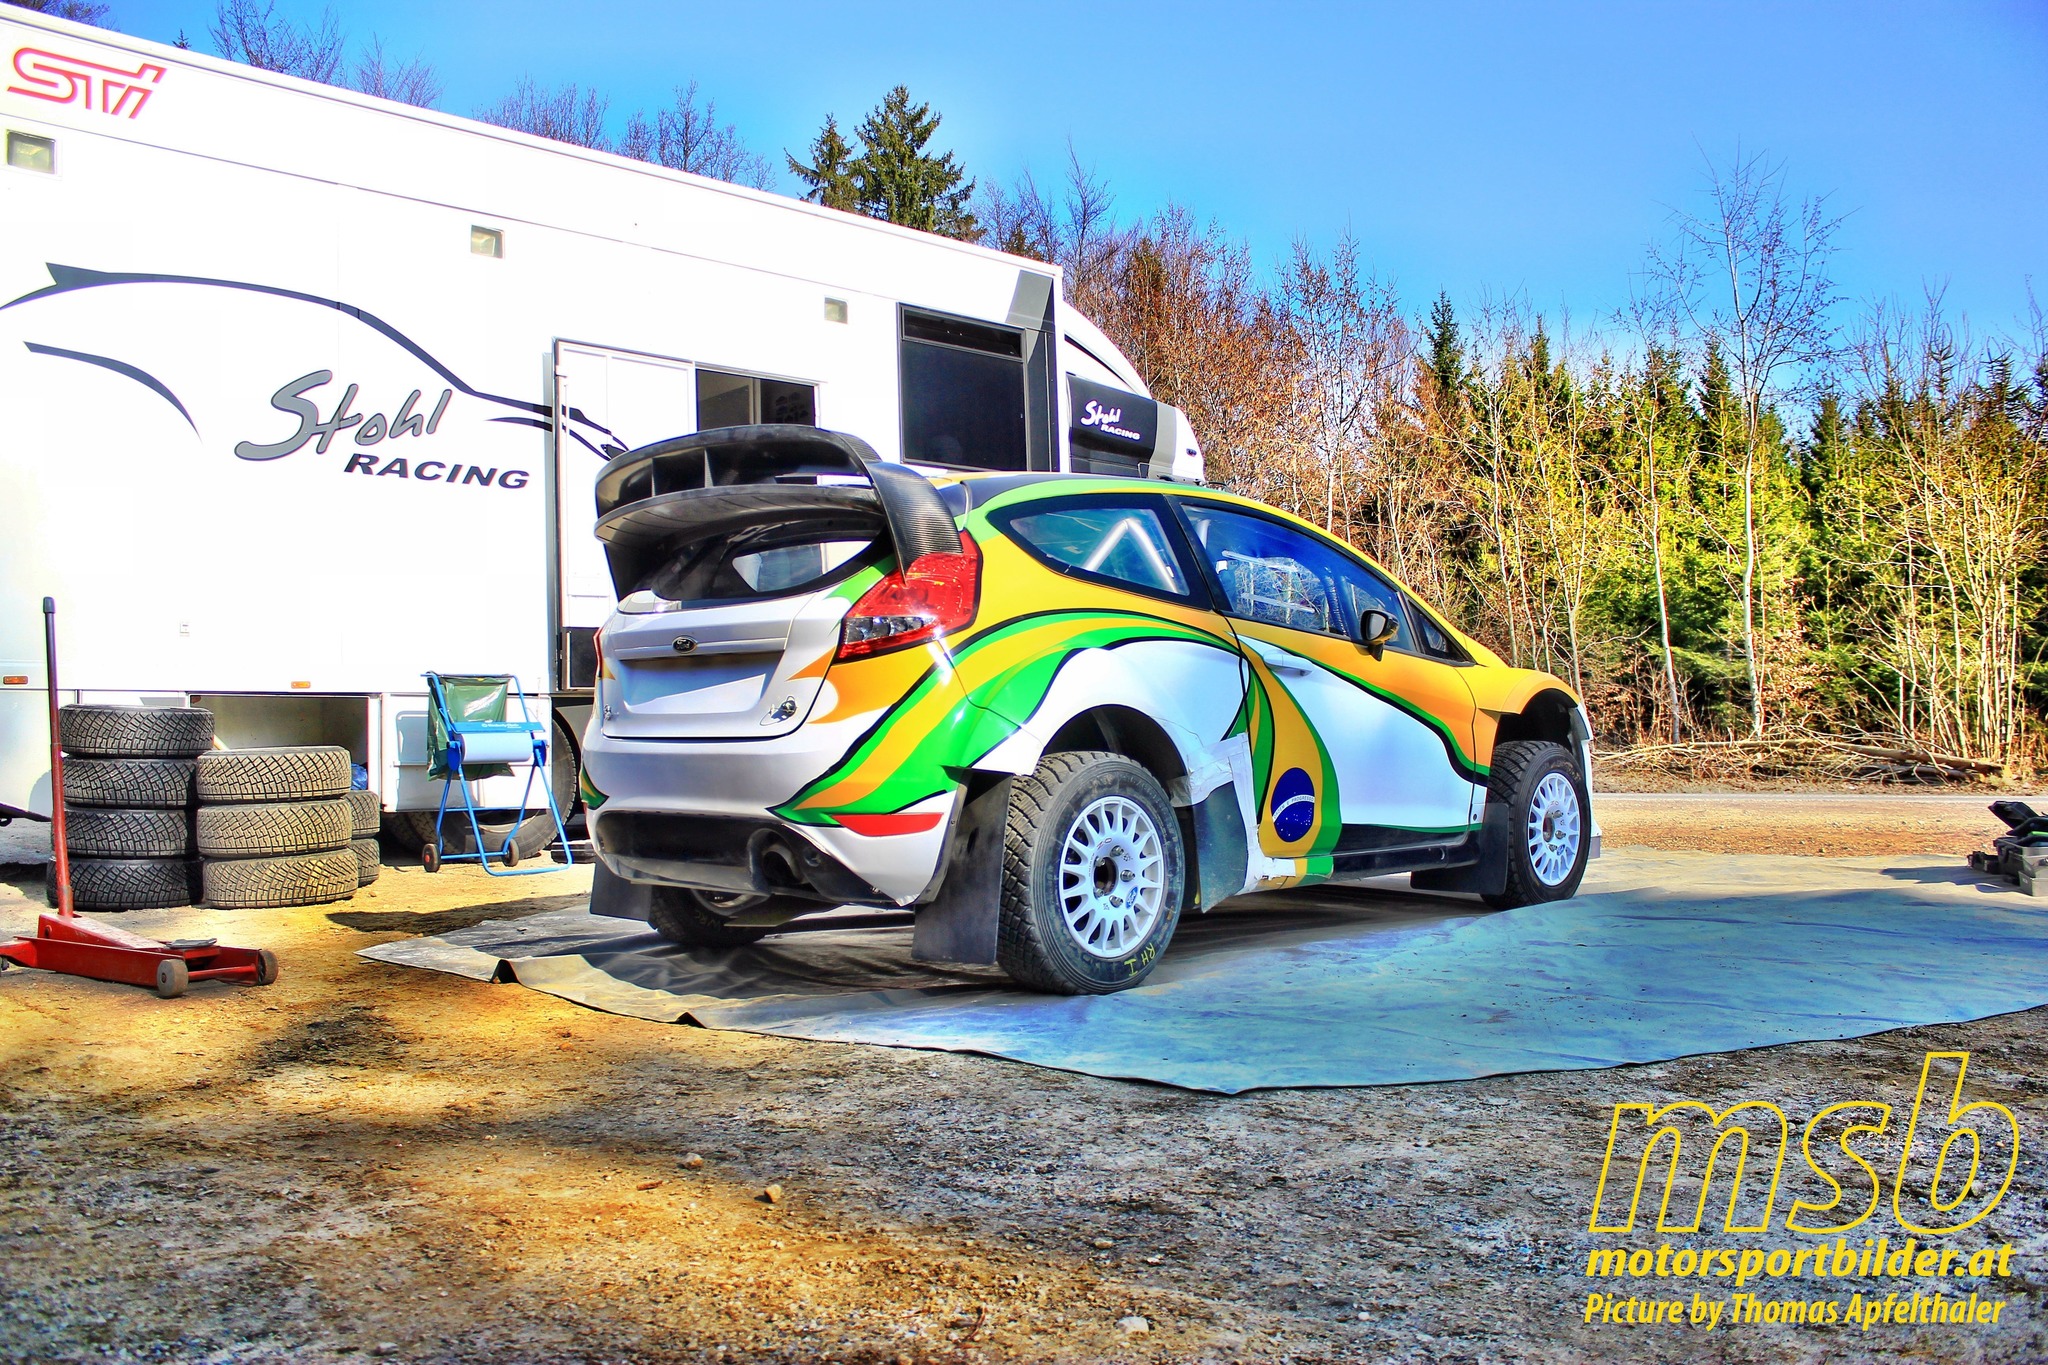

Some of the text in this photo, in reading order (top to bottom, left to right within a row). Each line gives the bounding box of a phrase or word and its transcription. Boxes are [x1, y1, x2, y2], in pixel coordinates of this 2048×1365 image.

[234, 369, 453, 461] Stohl
[1080, 400, 1121, 426] Stohl
[1100, 424, 1141, 440] RACING
[343, 453, 530, 490] RACING
